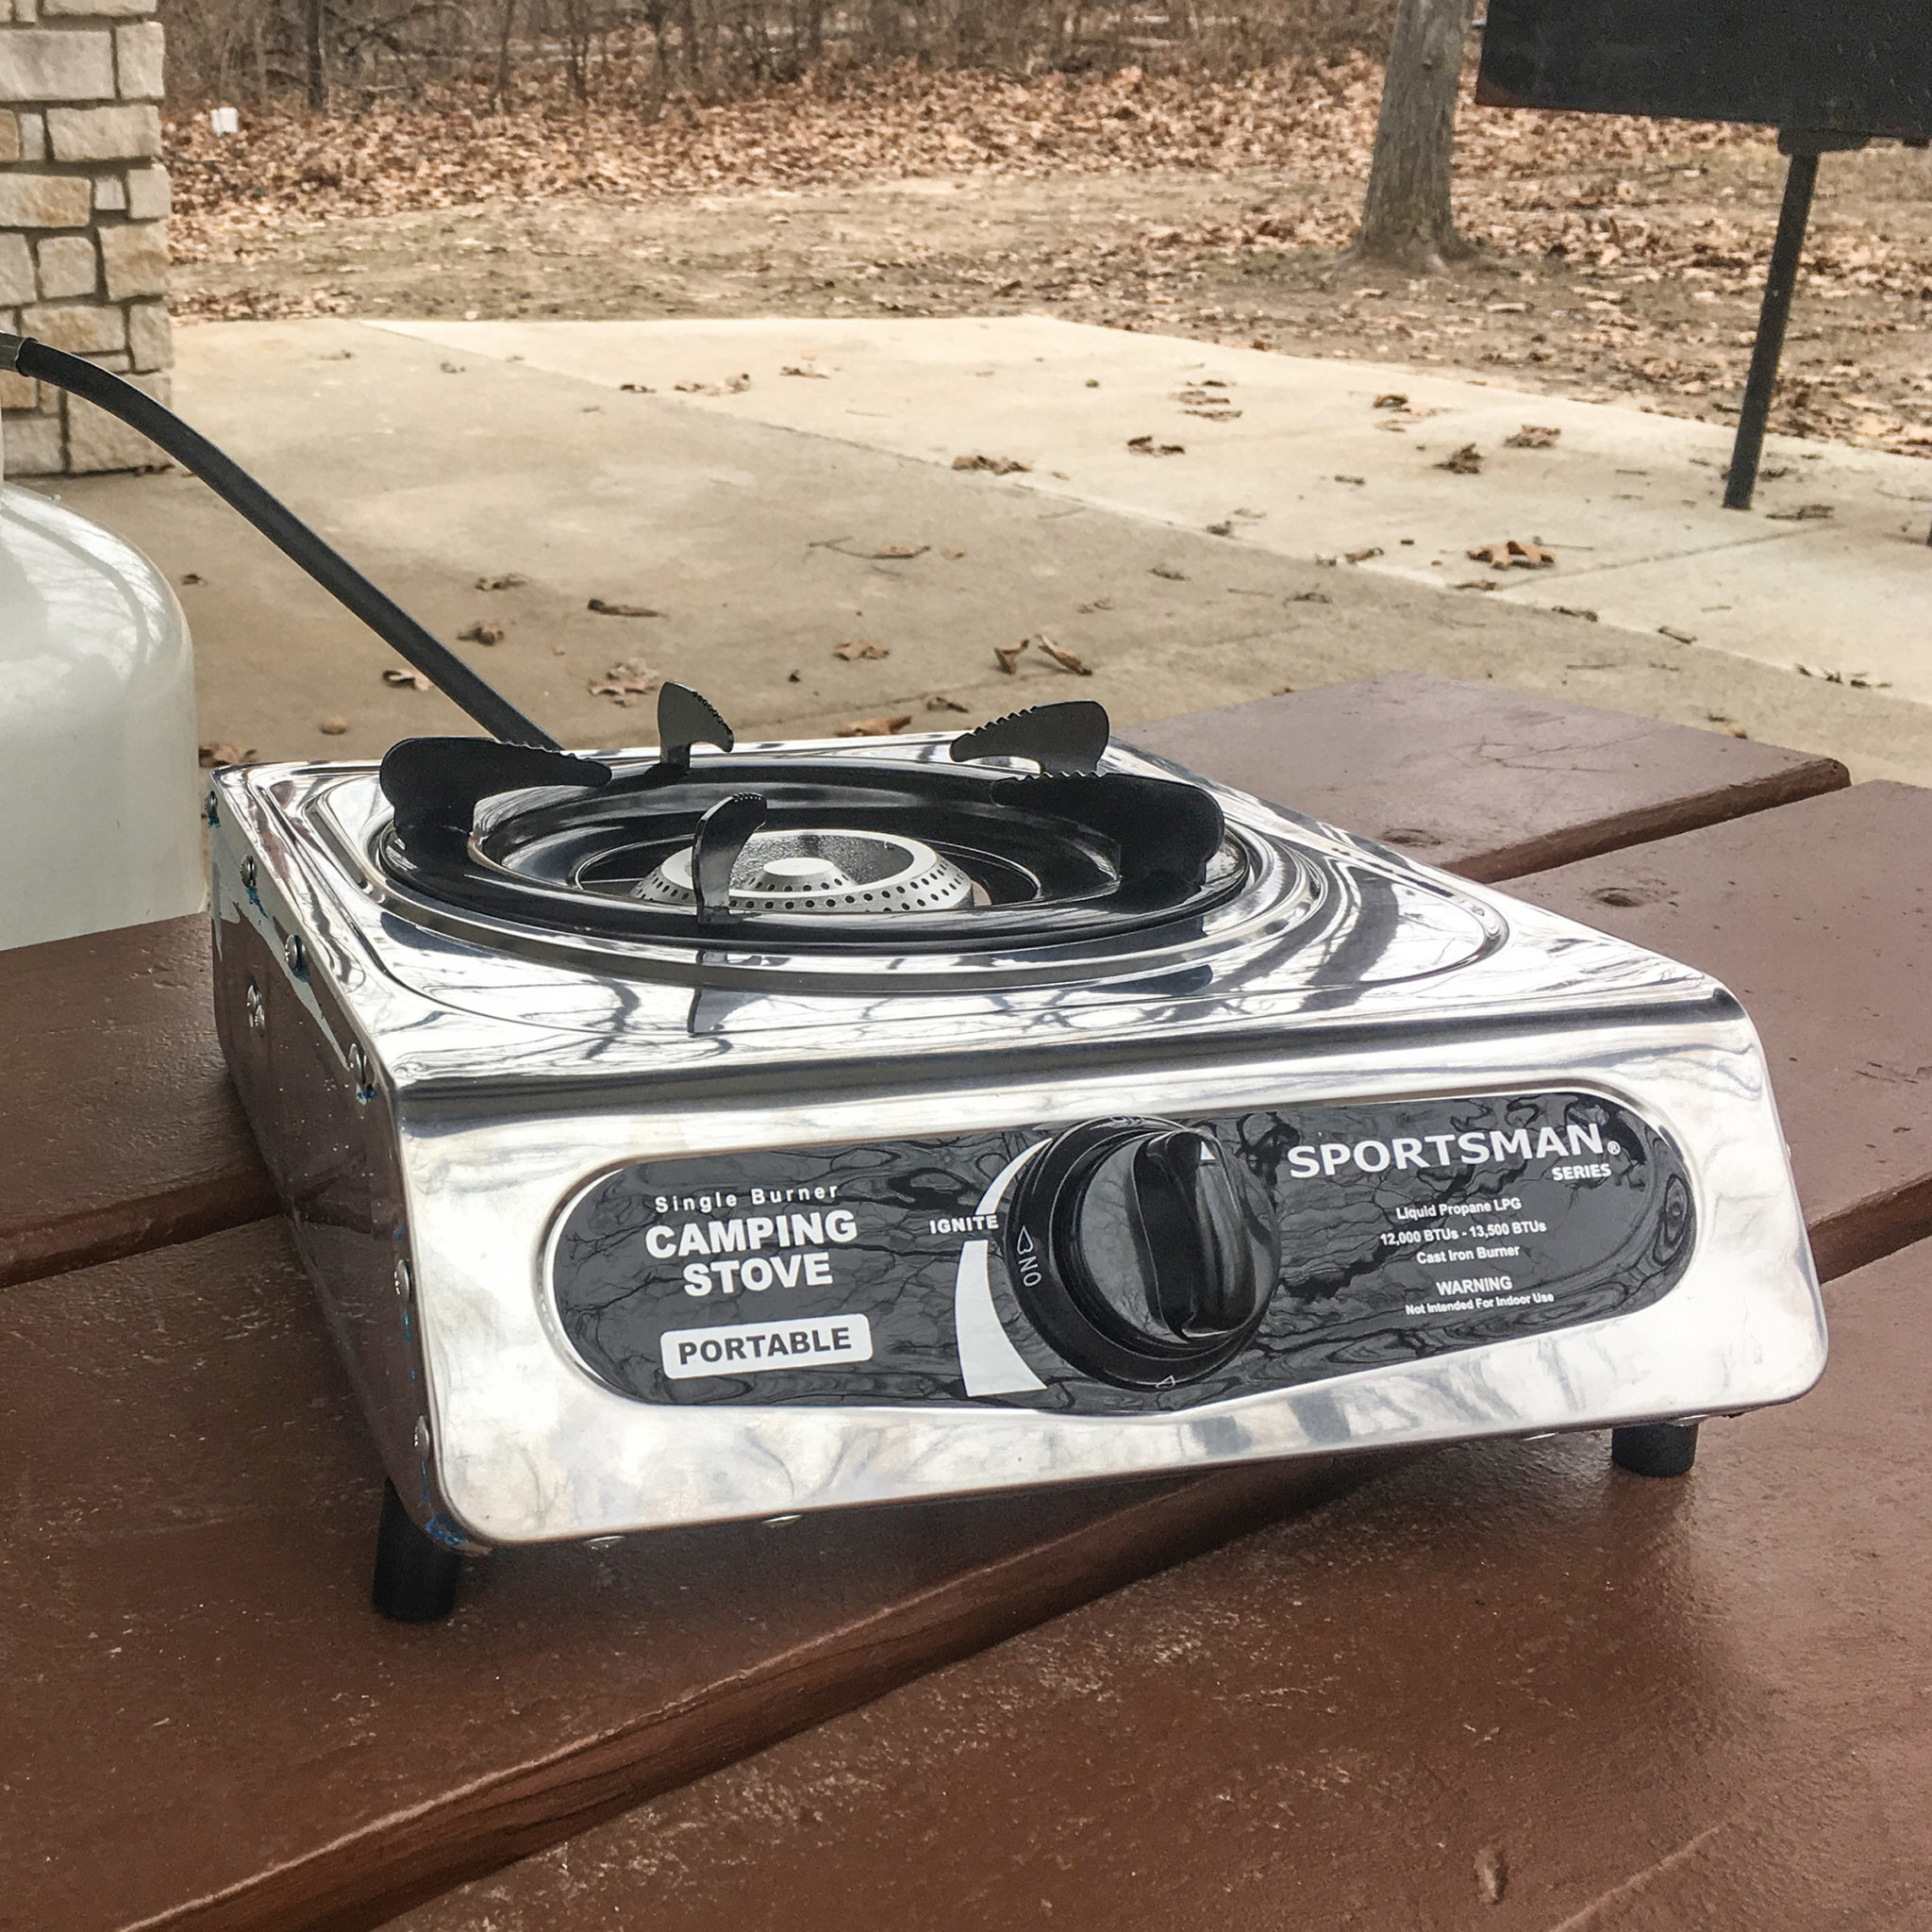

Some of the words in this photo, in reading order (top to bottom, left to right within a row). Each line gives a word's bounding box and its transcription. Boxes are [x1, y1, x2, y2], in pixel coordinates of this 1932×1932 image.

[1287, 1123, 1604, 1178] SPORTSMAN
[1552, 1163, 1612, 1181] SERIES
[655, 1191, 737, 1213] Single
[751, 1184, 838, 1206] Burner
[1396, 1205, 1437, 1221] Liquid
[1439, 1202, 1491, 1217] Propane
[1493, 1197, 1522, 1211] LPG
[645, 1209, 858, 1258] CAMPING
[929, 1214, 999, 1235] IGNITE
[1380, 1229, 1422, 1246] 12,000
[1424, 1227, 1459, 1242] BTUs
[1470, 1223, 1509, 1239] 13,500
[1512, 1220, 1547, 1235] BTUs
[1417, 1250, 1446, 1264] Cast
[1448, 1248, 1474, 1262] Iron
[1477, 1245, 1520, 1259] Burner
[683, 1252, 833, 1296] STOVE
[1019, 1256, 1041, 1287] ON
[1436, 1275, 1513, 1296] WARNING
[1406, 1304, 1425, 1315] Not
[1427, 1300, 1474, 1313] Intended
[1476, 1297, 1494, 1309] For
[1496, 1294, 1531, 1307] Indoor
[1533, 1291, 1555, 1304] Use
[678, 1326, 851, 1365] PORTABLE
